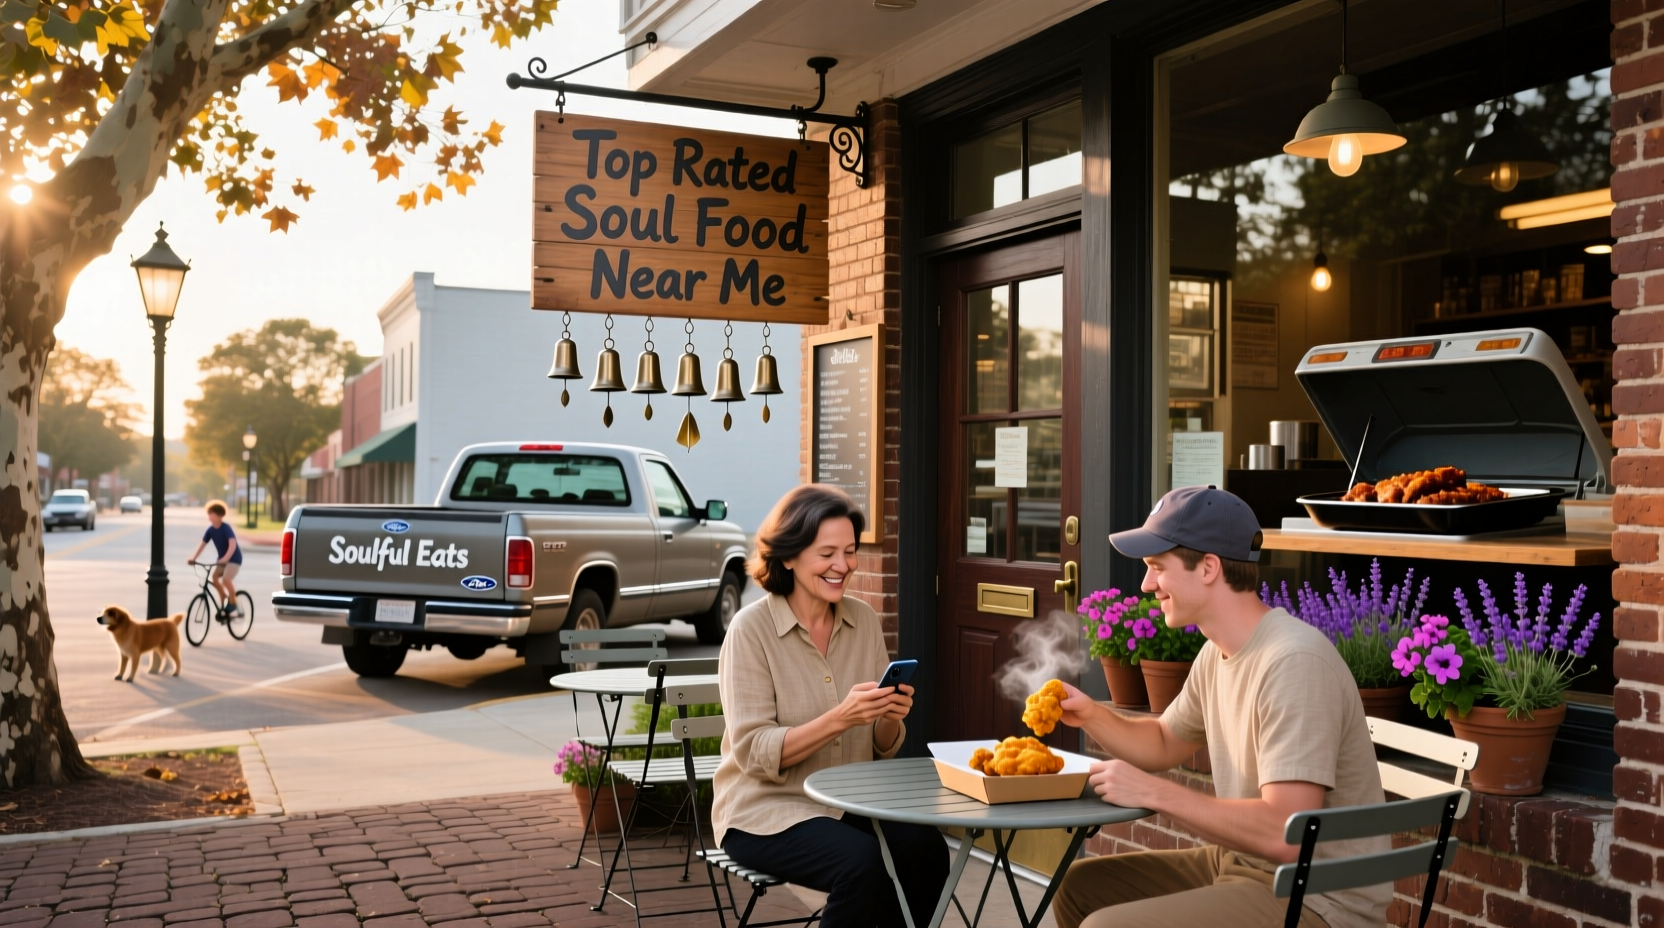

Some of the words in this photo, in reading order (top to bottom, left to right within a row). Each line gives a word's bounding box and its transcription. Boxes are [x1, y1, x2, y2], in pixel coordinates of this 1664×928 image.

[572, 129, 657, 197] Top
[672, 138, 798, 195] Rated
[560, 184, 679, 244] Soul
[696, 197, 809, 254] Food
[590, 248, 707, 301] Near
[719, 258, 786, 307] Me
[328, 535, 411, 571] Soulful
[416, 539, 469, 569] Eats
